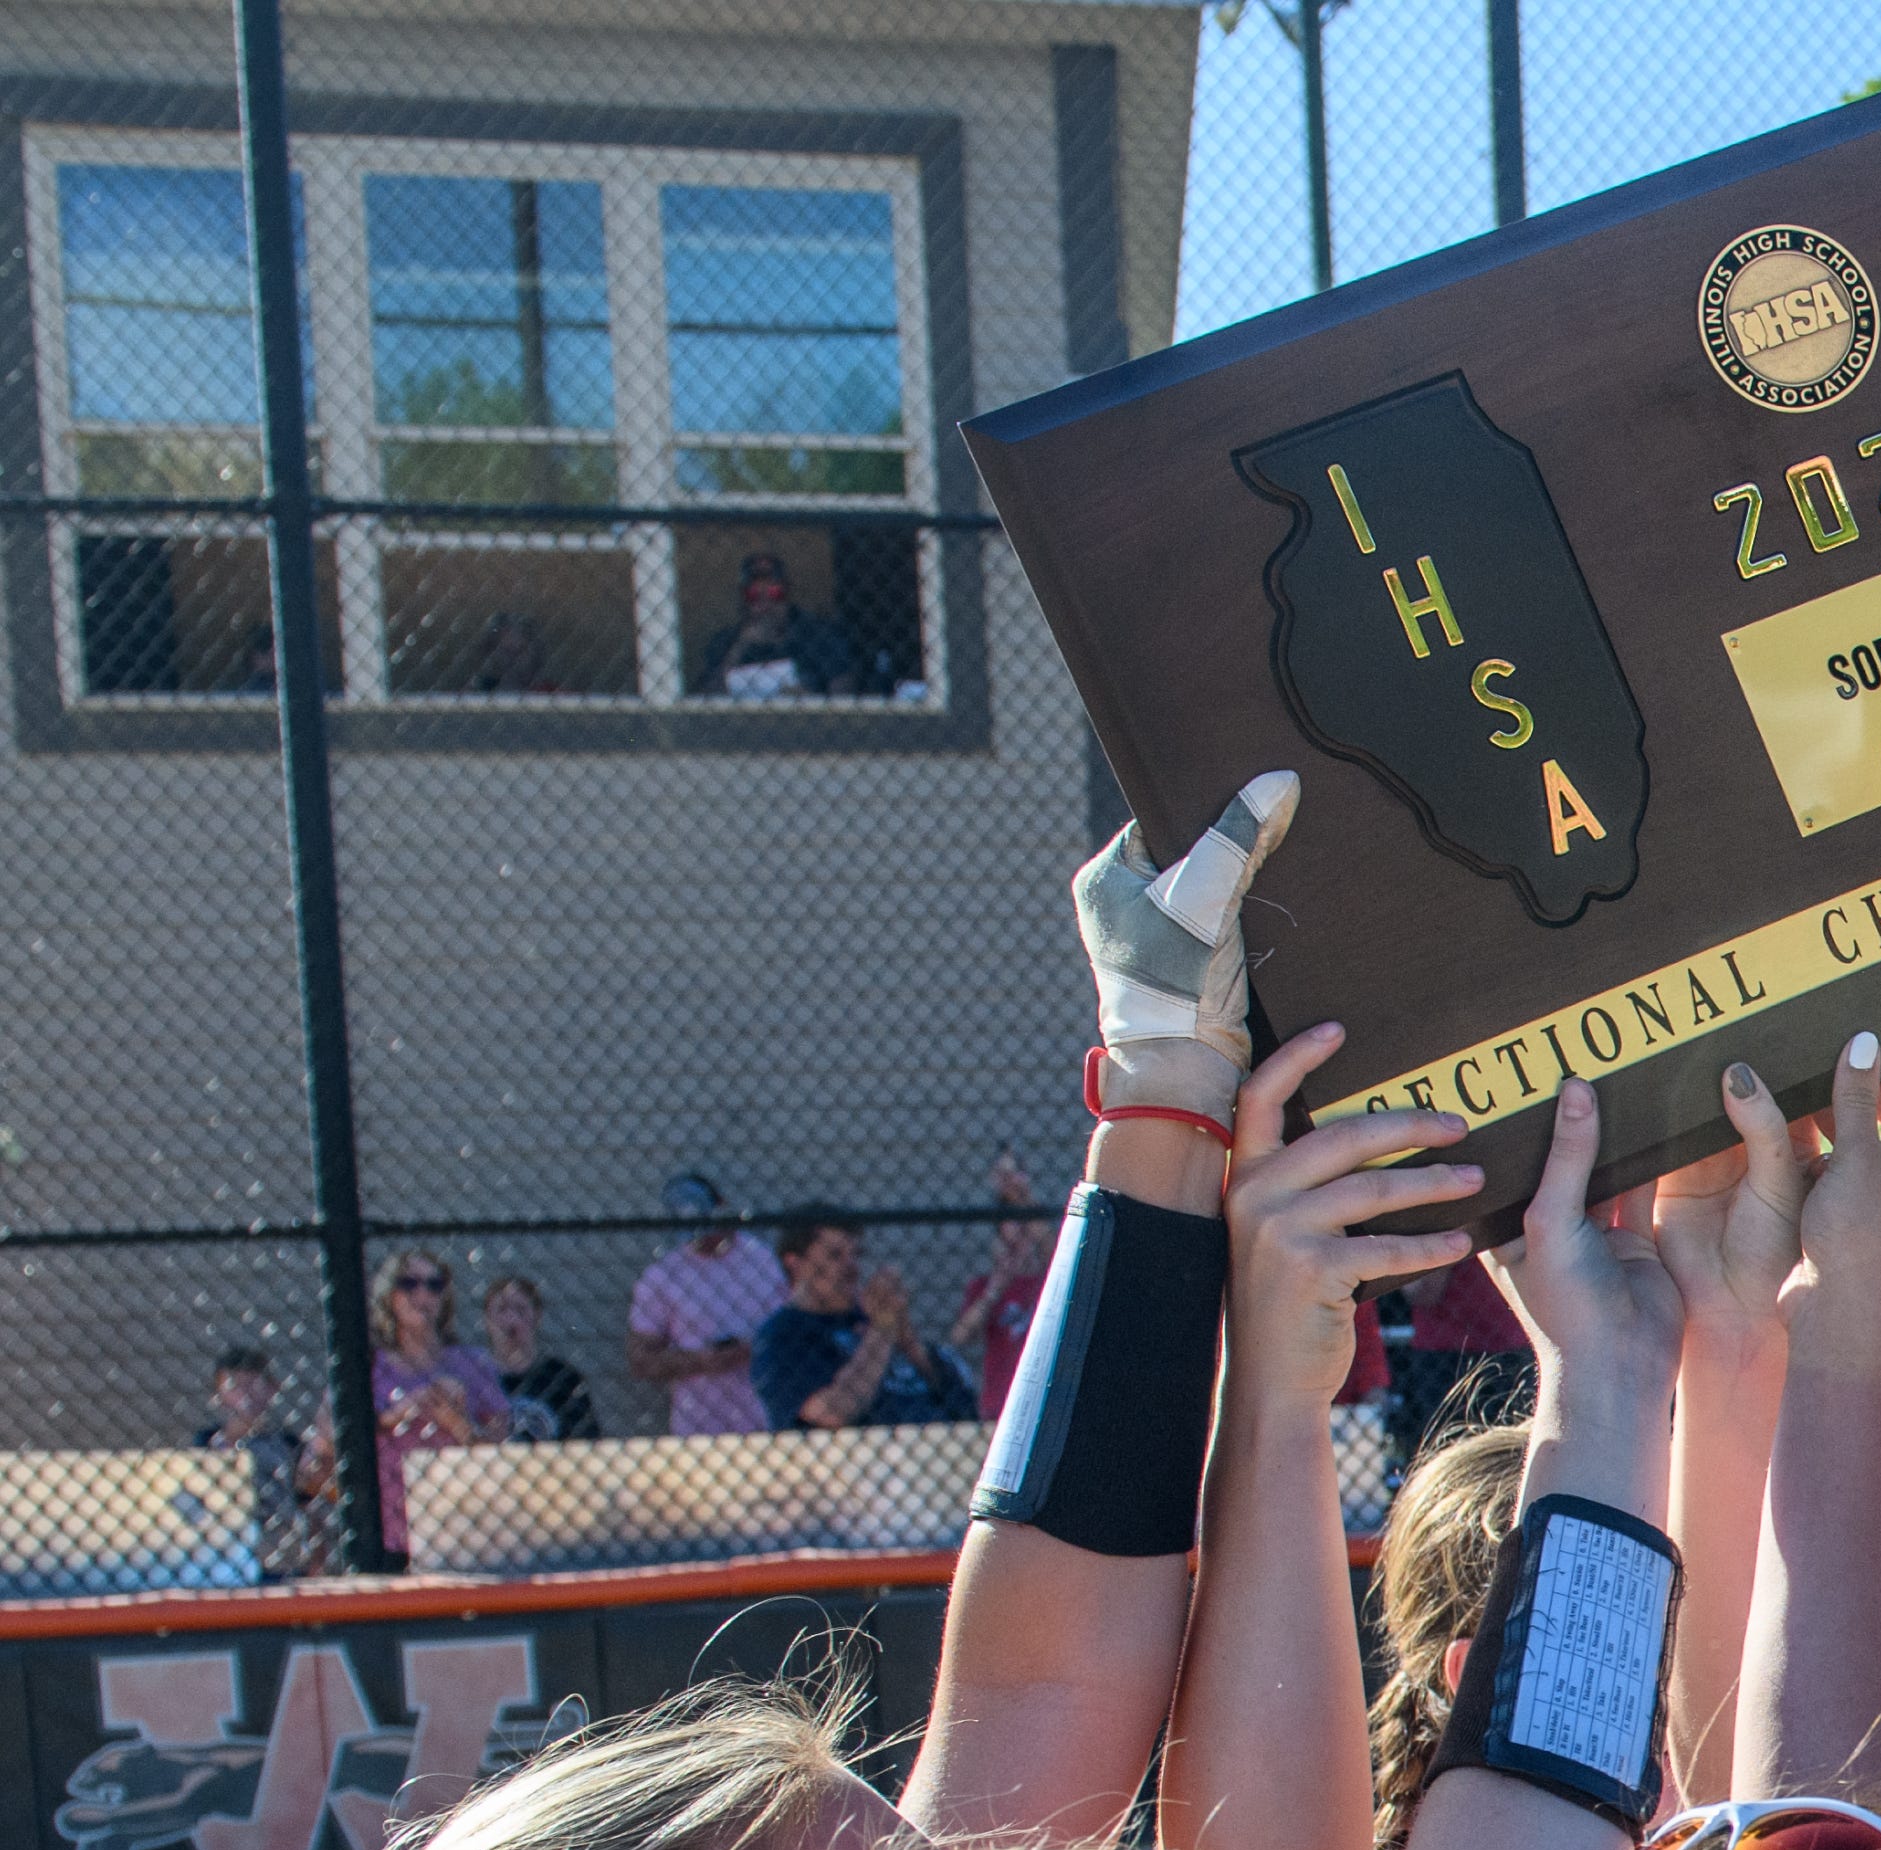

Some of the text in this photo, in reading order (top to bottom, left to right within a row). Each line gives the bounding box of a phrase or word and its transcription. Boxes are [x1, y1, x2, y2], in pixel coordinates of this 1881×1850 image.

[1706, 232, 1871, 367] ILLINOIS HIGH SCHOOL
[1738, 335, 1871, 405] ASSOCIATION
